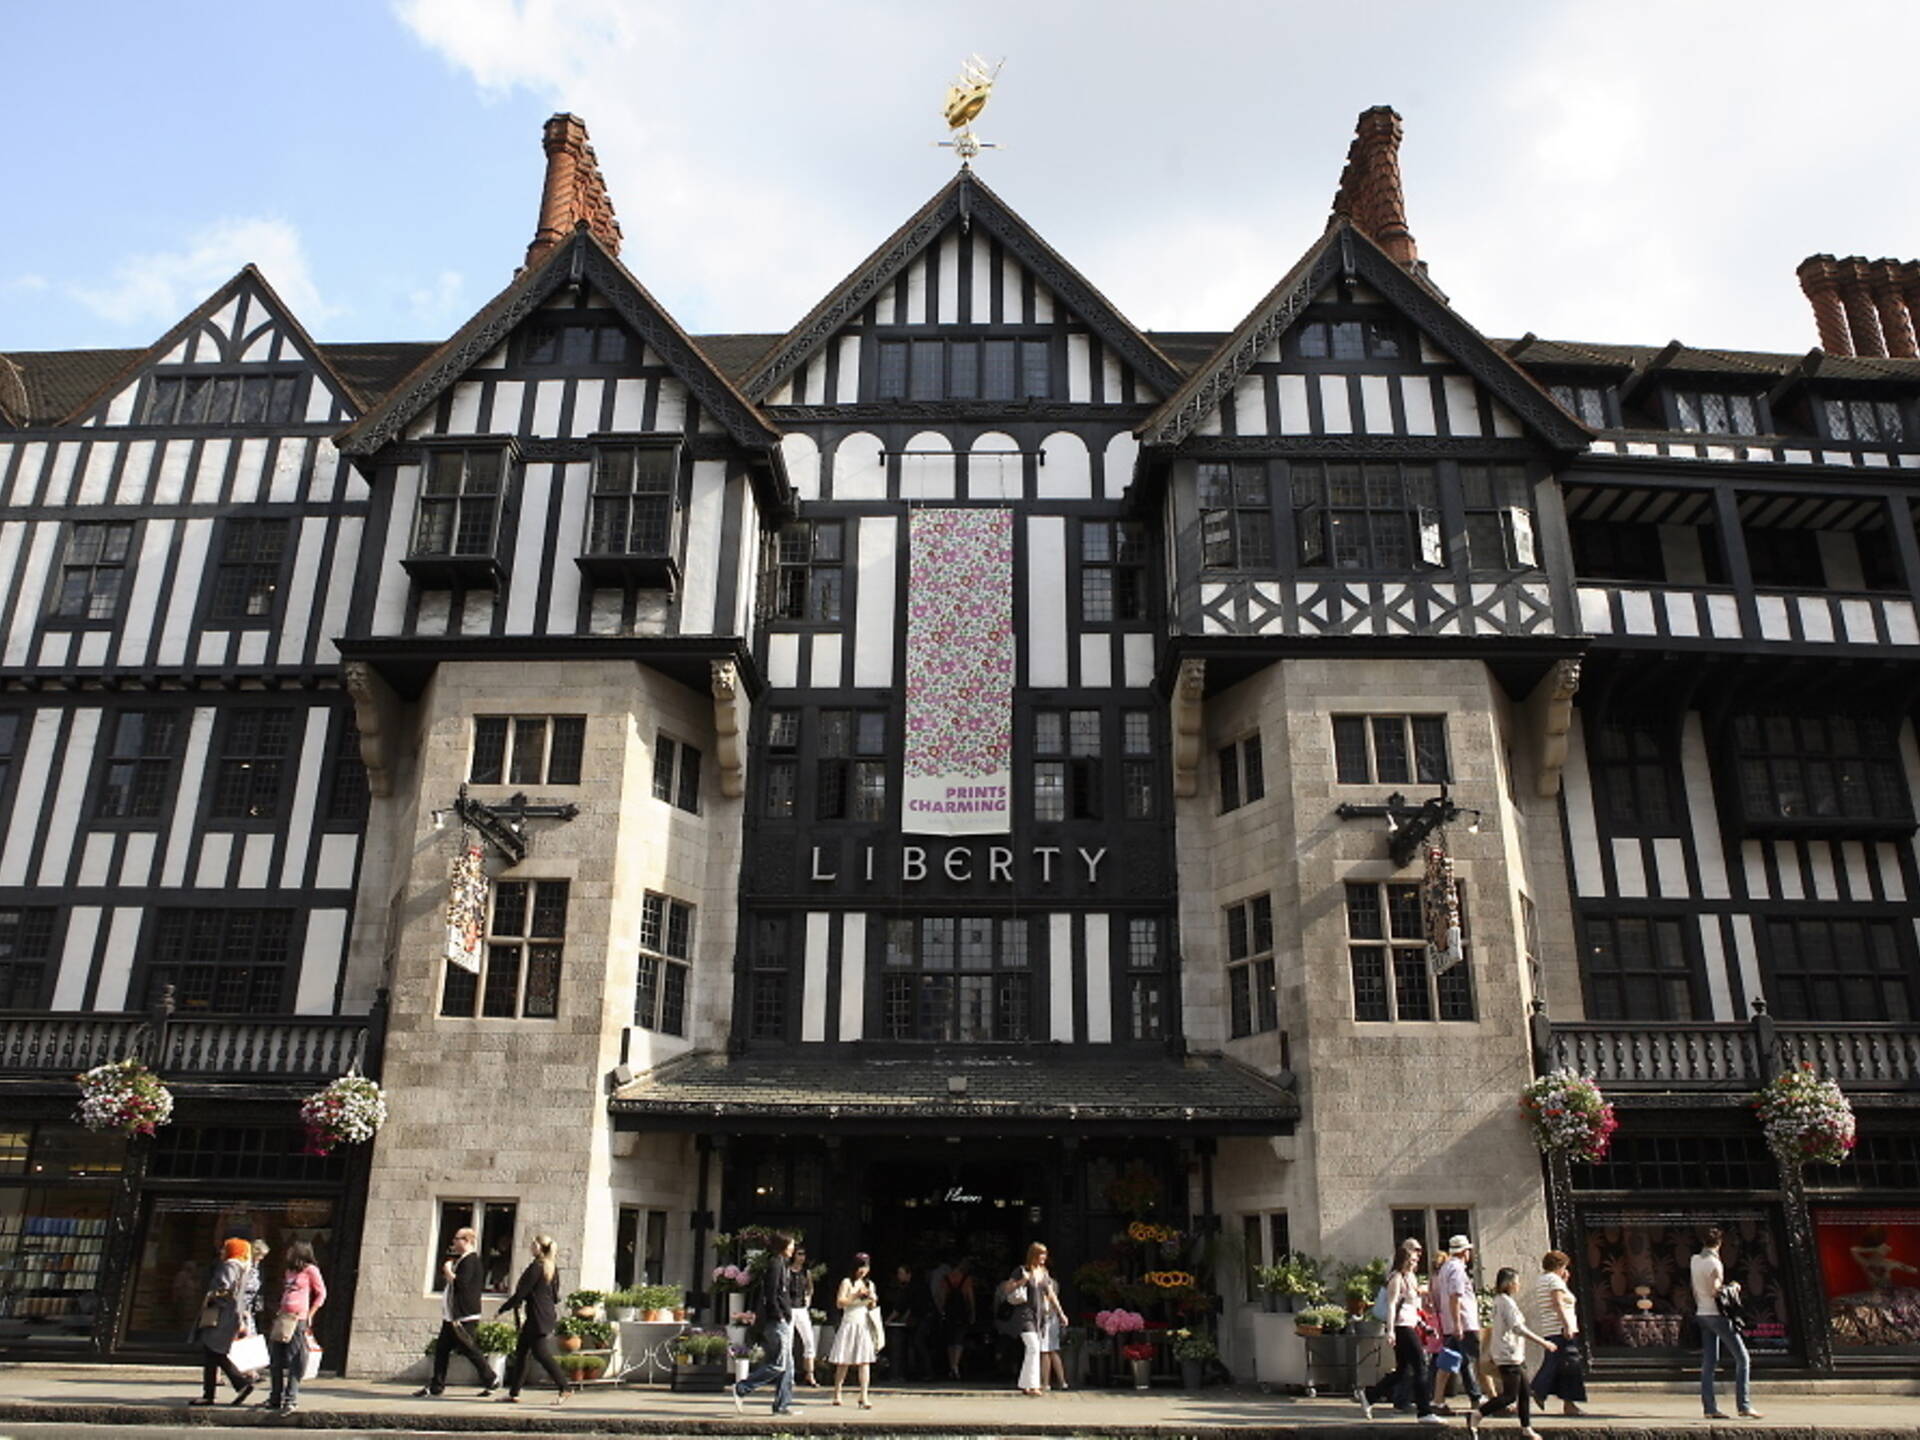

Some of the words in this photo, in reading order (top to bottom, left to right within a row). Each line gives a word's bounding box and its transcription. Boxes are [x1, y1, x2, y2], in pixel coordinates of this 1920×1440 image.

[946, 786, 1006, 798] PRINTS
[909, 799, 1006, 813] CHARMING
[810, 846, 1107, 882] LIBERTY
